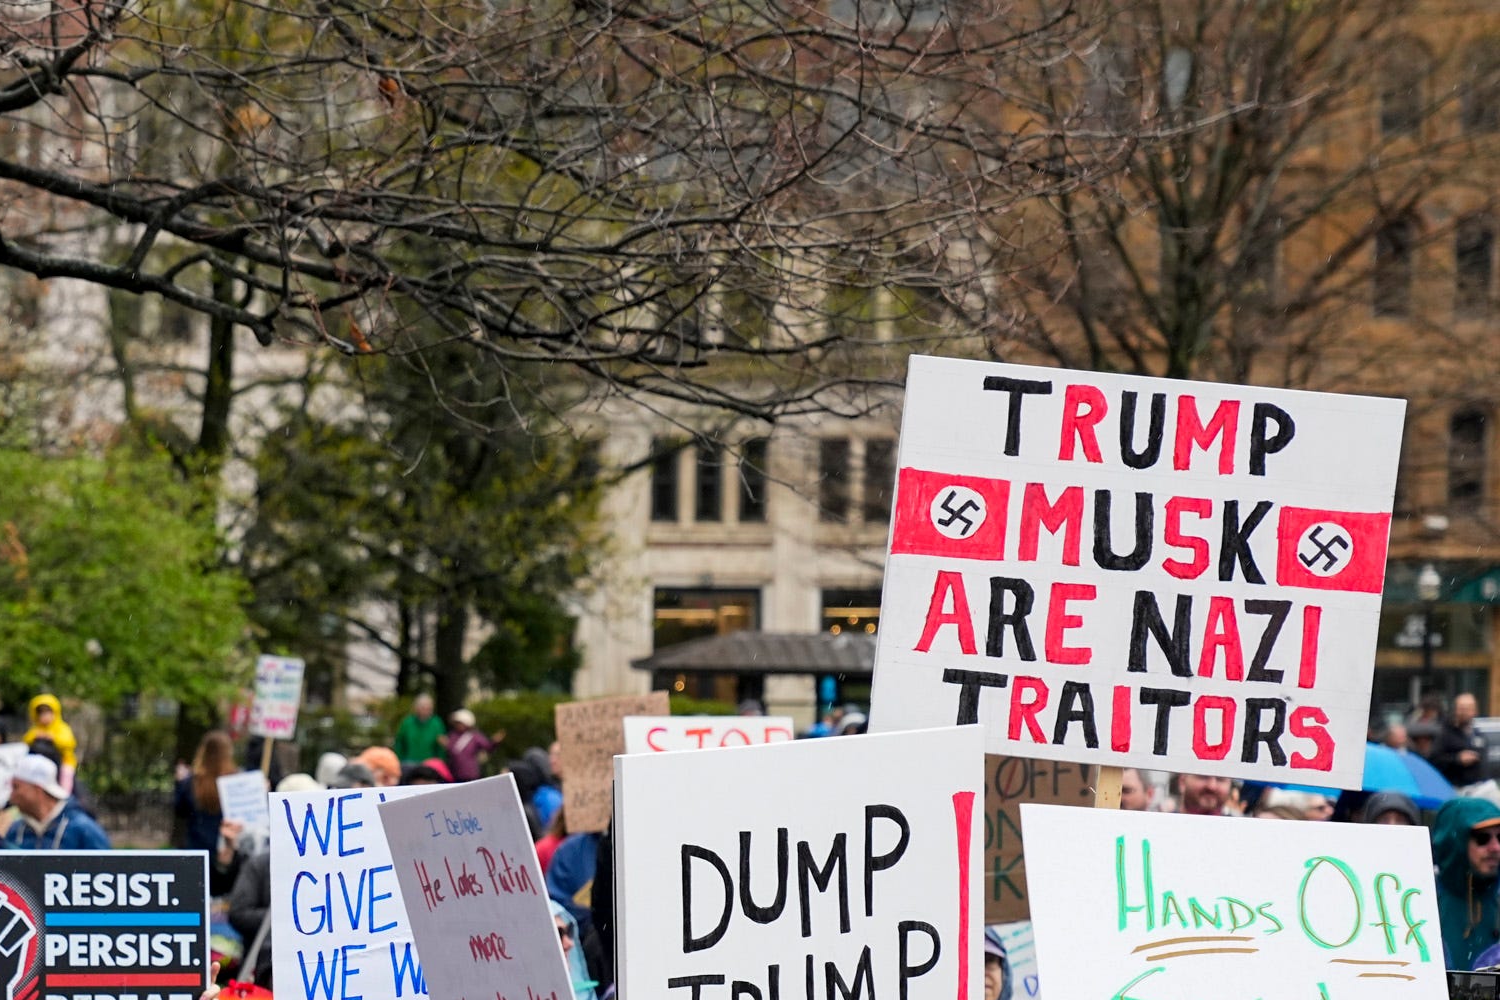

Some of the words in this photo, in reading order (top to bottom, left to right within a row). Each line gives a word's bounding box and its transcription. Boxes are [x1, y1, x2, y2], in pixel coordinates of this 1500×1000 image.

[983, 376, 1295, 476] TRUMP
[1018, 482, 1273, 584] MUSK
[913, 570, 1097, 664] ARE
[1127, 590, 1322, 689] NAZI
[943, 668, 1335, 772] TRAITORS
[282, 792, 365, 857] WE
[424, 812, 442, 837] I
[44, 873, 180, 907] RESIST.
[292, 864, 398, 935] GIVE
[413, 858, 446, 912] He
[476, 846, 538, 897] Putin
[681, 804, 911, 954] DUMP
[44, 933, 201, 967] PERSIST.
[390, 942, 429, 998] W
[468, 932, 513, 962] more
